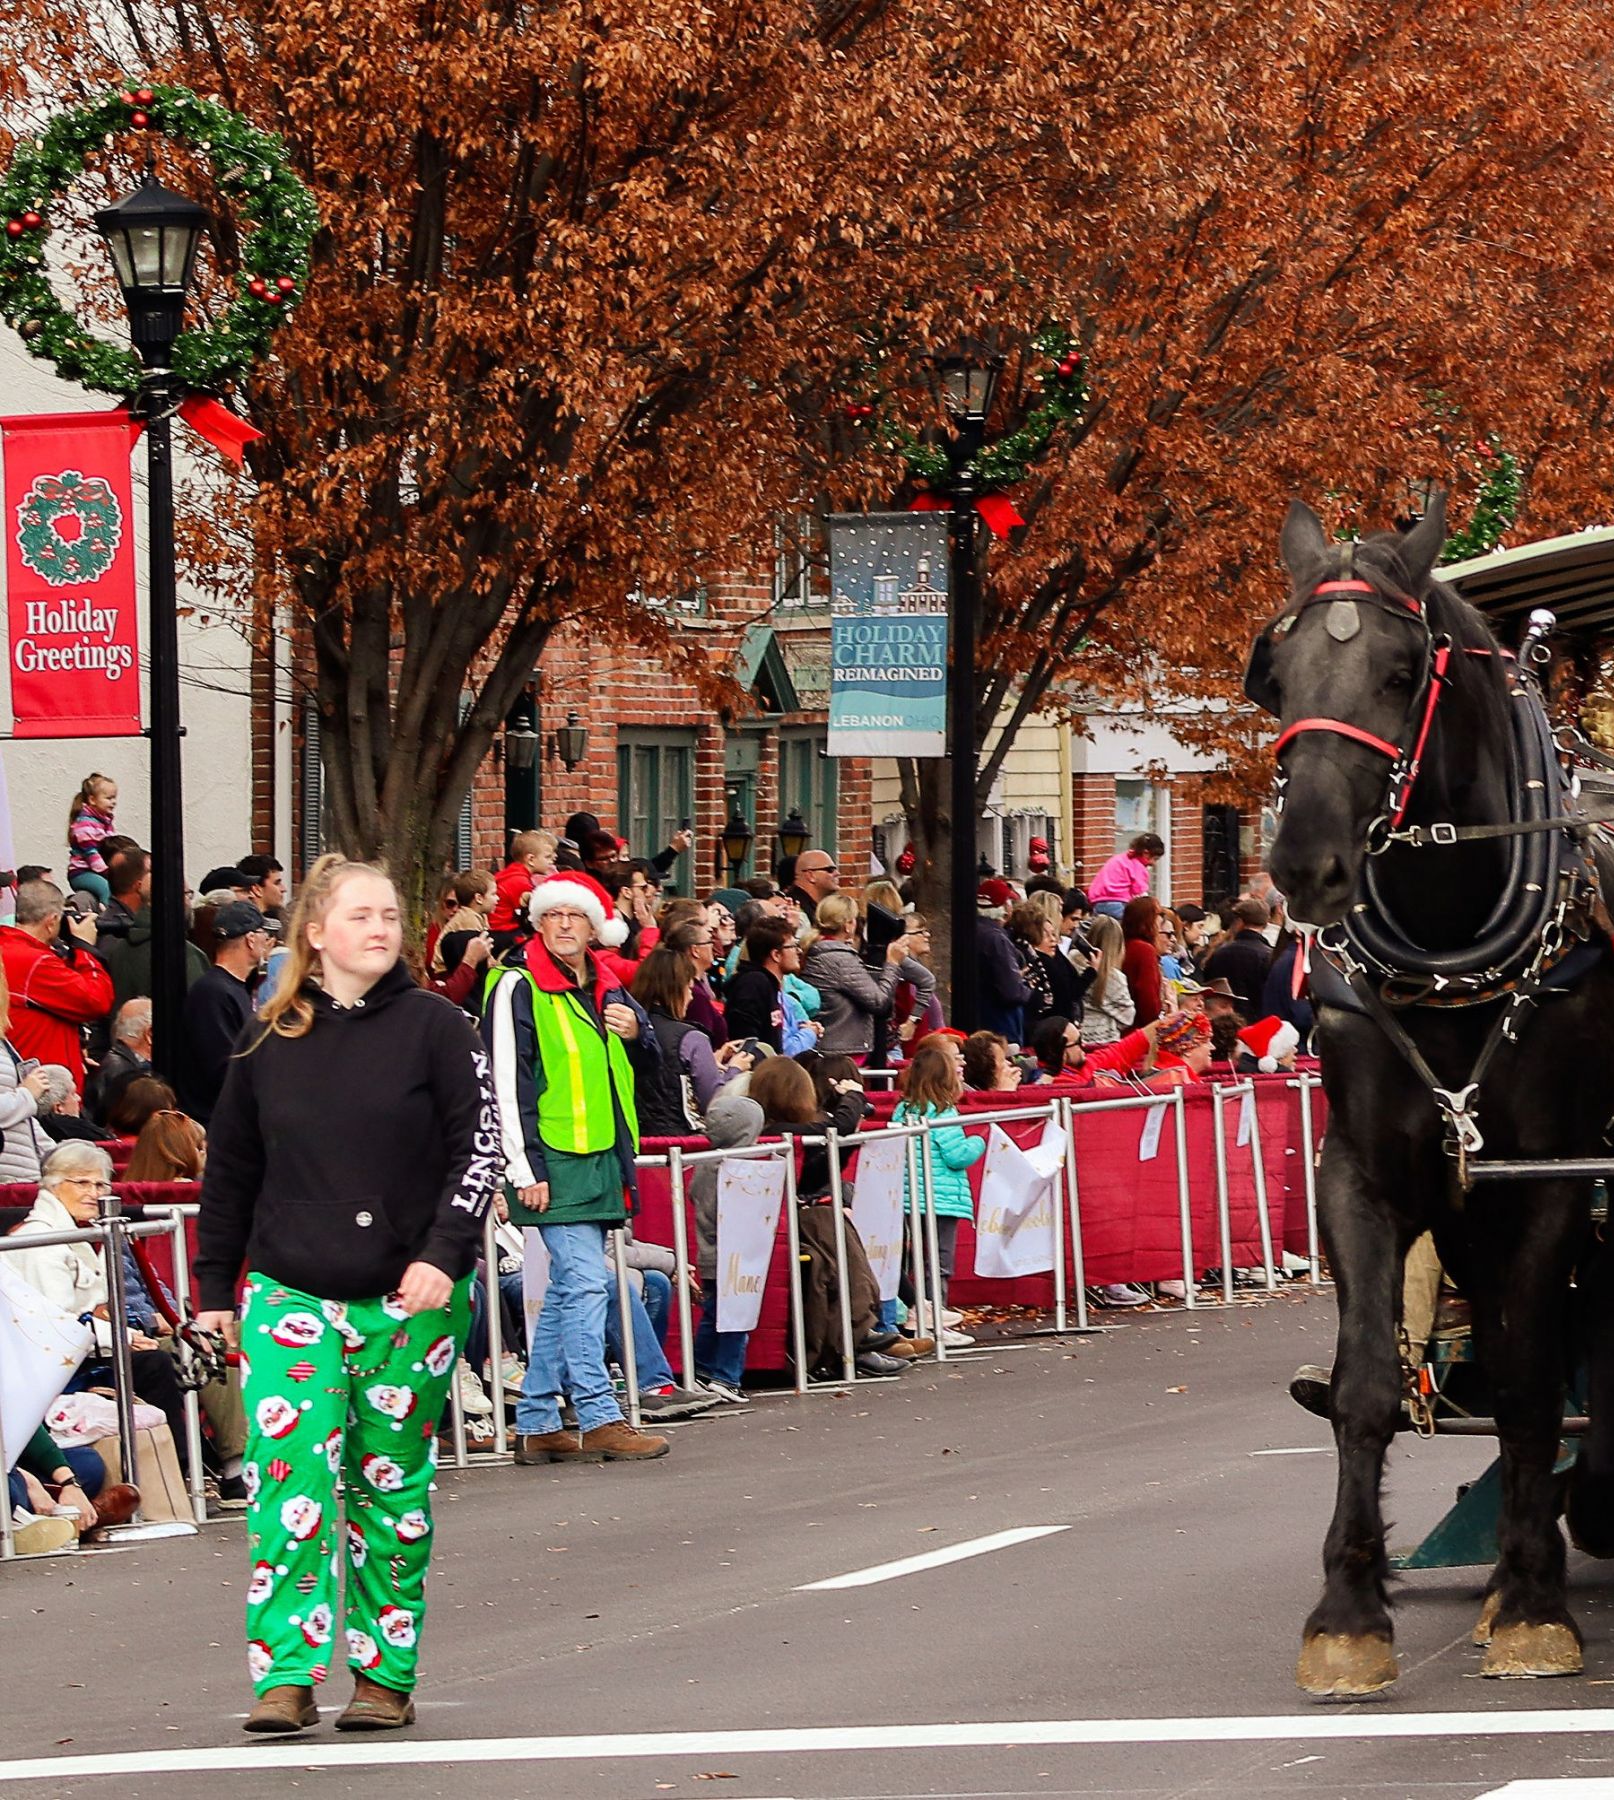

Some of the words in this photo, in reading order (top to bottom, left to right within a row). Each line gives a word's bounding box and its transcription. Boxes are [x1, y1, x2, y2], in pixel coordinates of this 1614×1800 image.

[26, 598, 119, 642] Holiday
[835, 625, 944, 644] HOLIDAY
[15, 636, 133, 681] Greetings
[834, 644, 943, 666] CHARM
[833, 667, 944, 682] REIMAGINED
[832, 714, 904, 728] LEBANON
